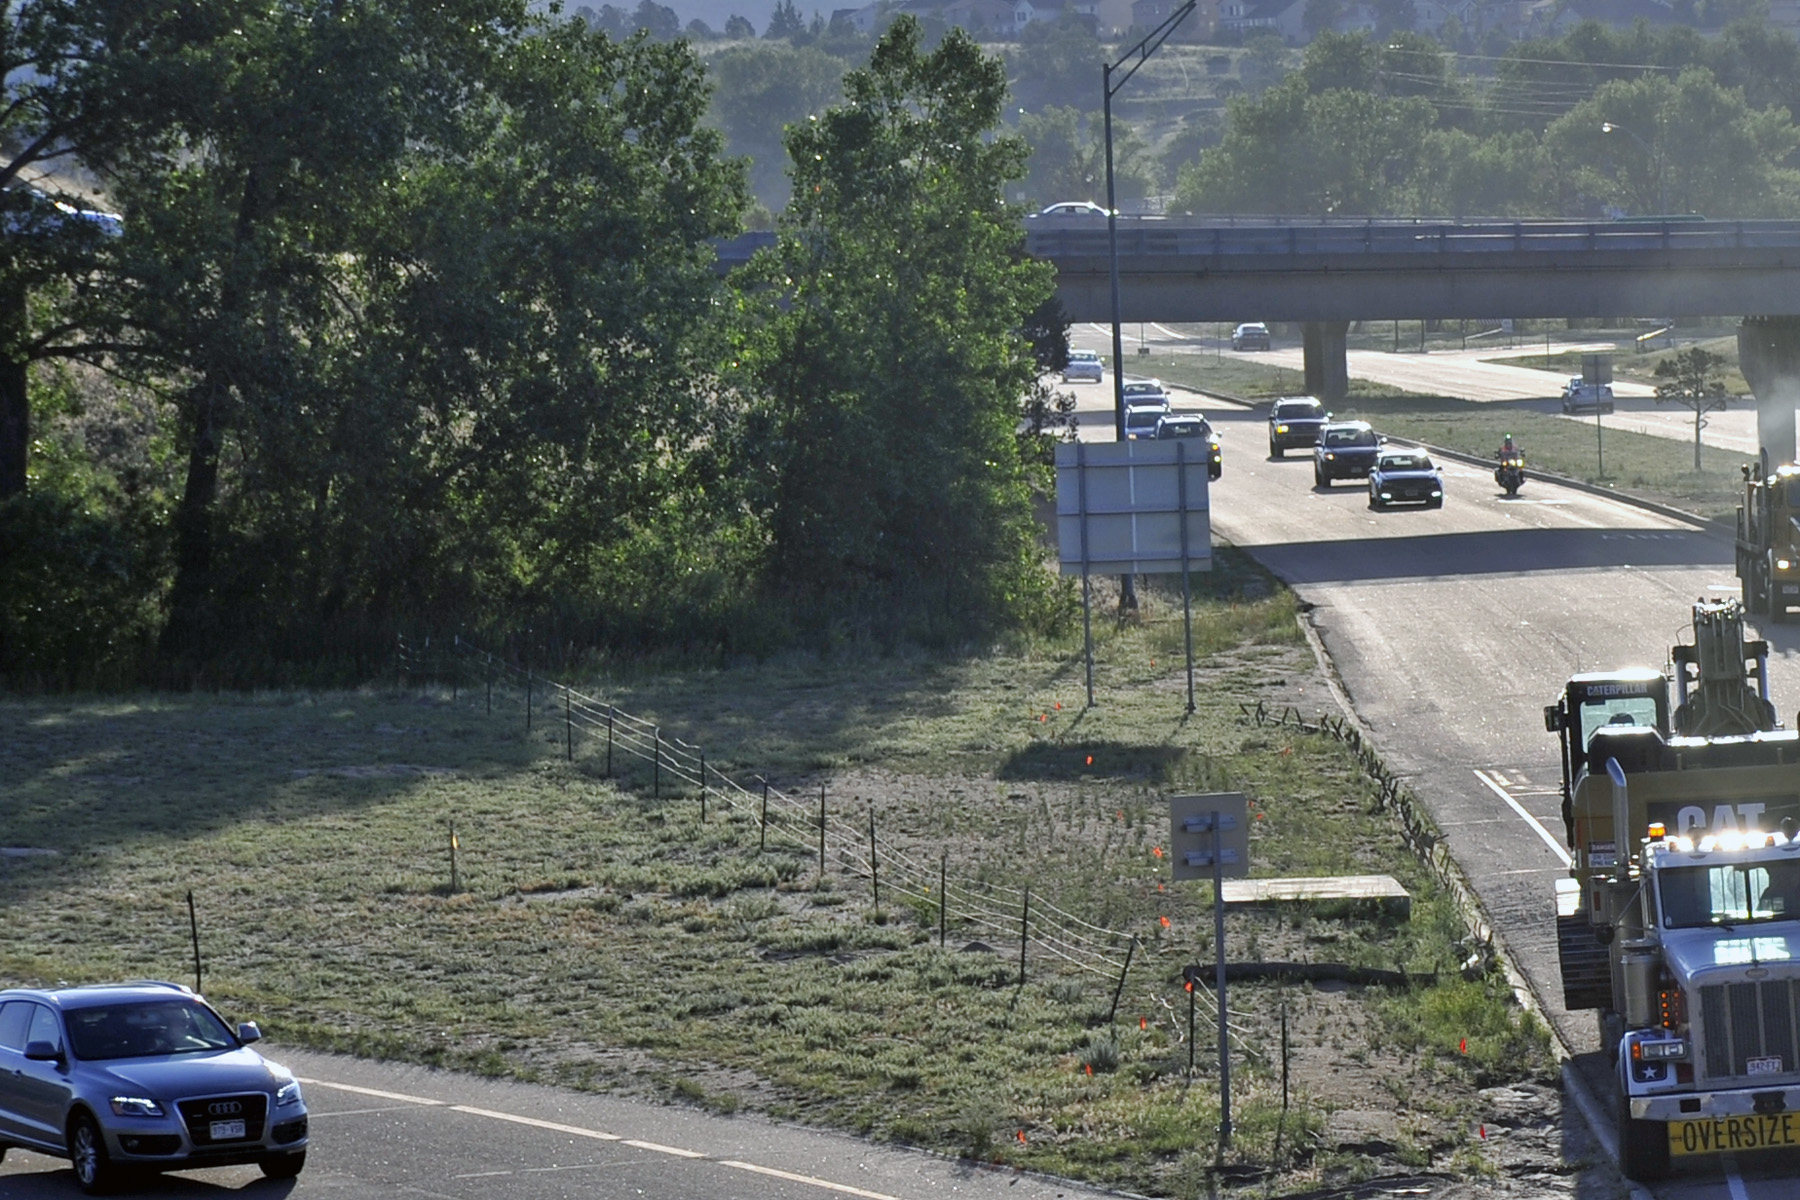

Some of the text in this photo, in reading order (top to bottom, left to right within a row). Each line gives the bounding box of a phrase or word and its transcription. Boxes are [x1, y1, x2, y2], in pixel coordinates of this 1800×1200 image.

[1587, 683, 1648, 696] CATERPILLAR
[1677, 803, 1765, 838] CAT
[1682, 1114, 1796, 1152] OVERSIZE
